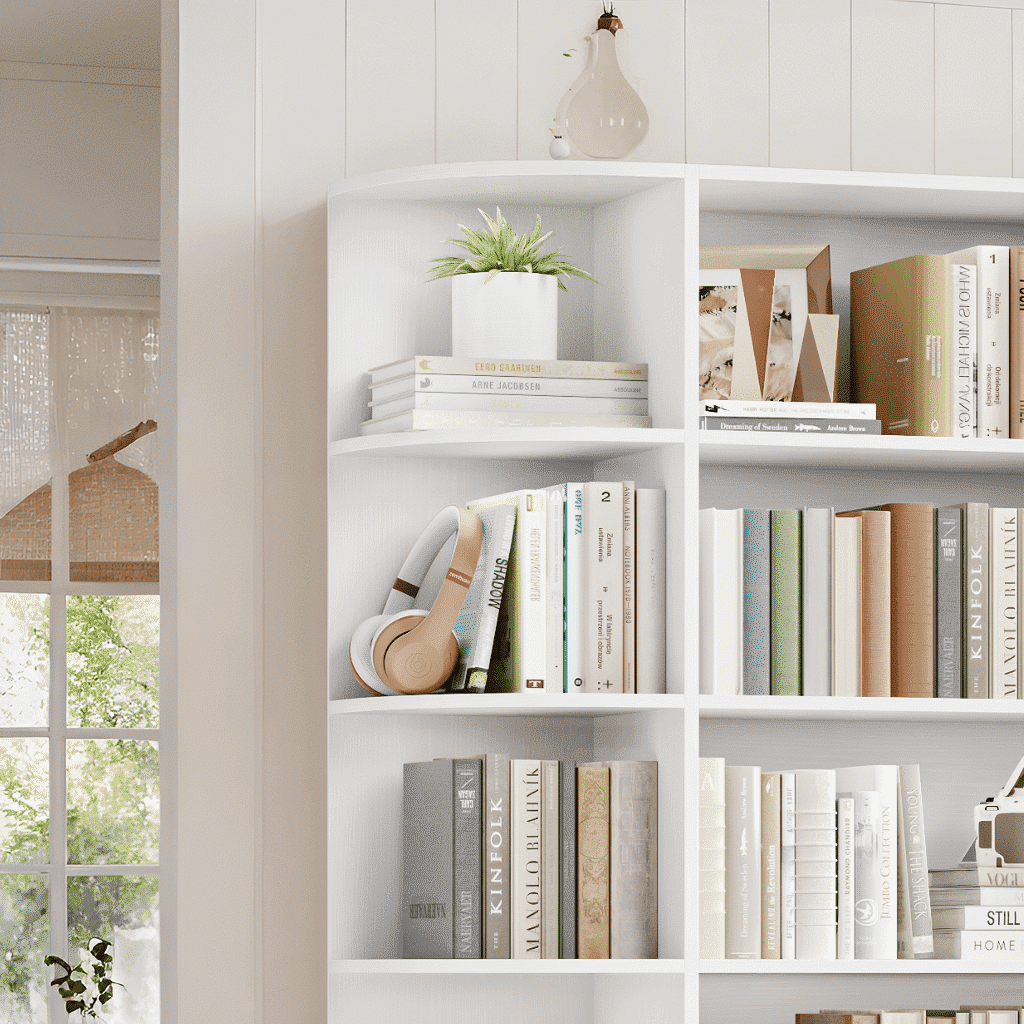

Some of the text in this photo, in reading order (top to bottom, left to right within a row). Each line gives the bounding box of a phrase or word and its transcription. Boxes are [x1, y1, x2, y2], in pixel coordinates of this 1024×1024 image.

[989, 254, 996, 264] 1
[994, 292, 1002, 315] Zmiana
[472, 380, 541, 391] ARNE JACOBSEN
[720, 422, 753, 431] Dreaming
[753, 422, 761, 431] of
[761, 423, 788, 431] Sweden
[827, 424, 847, 432] Andrew
[601, 491, 611, 502] 2
[488, 557, 508, 610] SHADOW
[969, 545, 983, 660] KINFOLK
[605, 622, 613, 655] labiryncie
[1003, 606, 1017, 696] MANOLO
[489, 797, 503, 915] KINFOLK
[522, 767, 540, 953] MANOLO BLAHNÍK
[766, 844, 776, 893] Revolution
[906, 787, 929, 921] YOUNG THE SHACK
[740, 863, 748, 892] Sweden
[740, 902, 749, 938] Dreaming
[986, 910, 1021, 926] STILL
